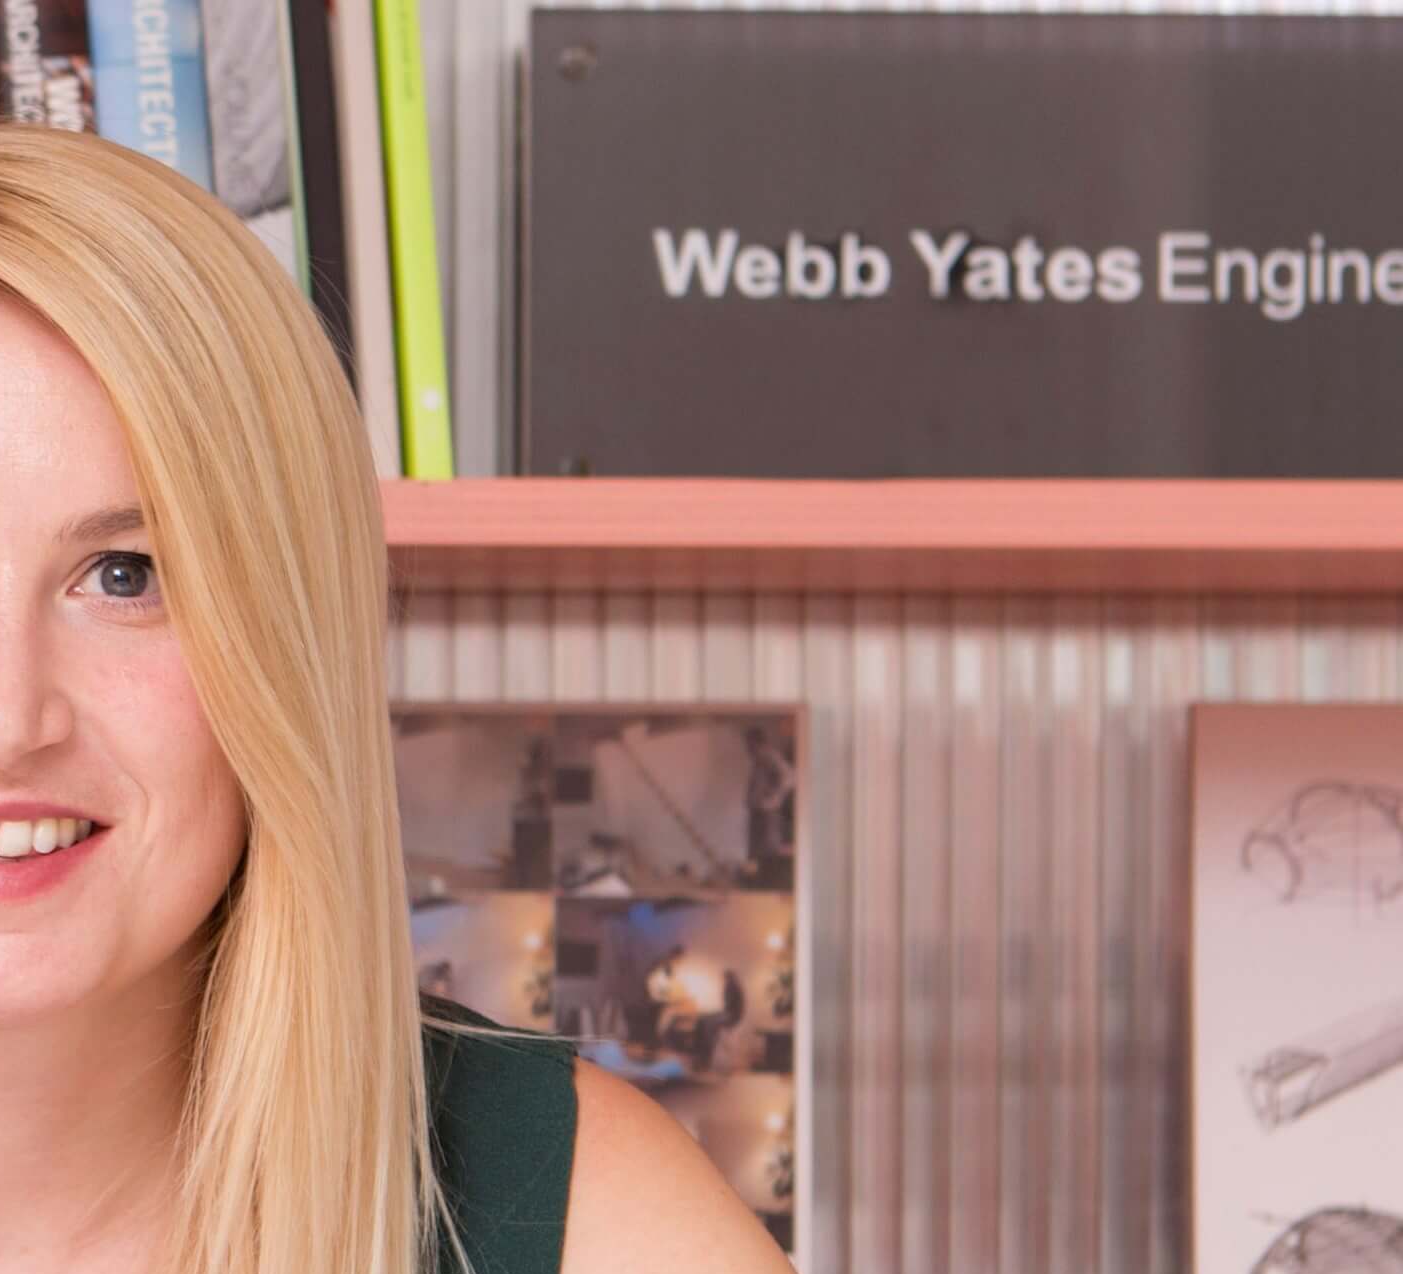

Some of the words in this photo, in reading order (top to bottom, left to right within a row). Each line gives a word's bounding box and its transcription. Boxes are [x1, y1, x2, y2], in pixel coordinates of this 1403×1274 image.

[133, 0, 179, 168] CHITECT
[652, 226, 892, 298] Webb
[910, 228, 1144, 302] Yates
